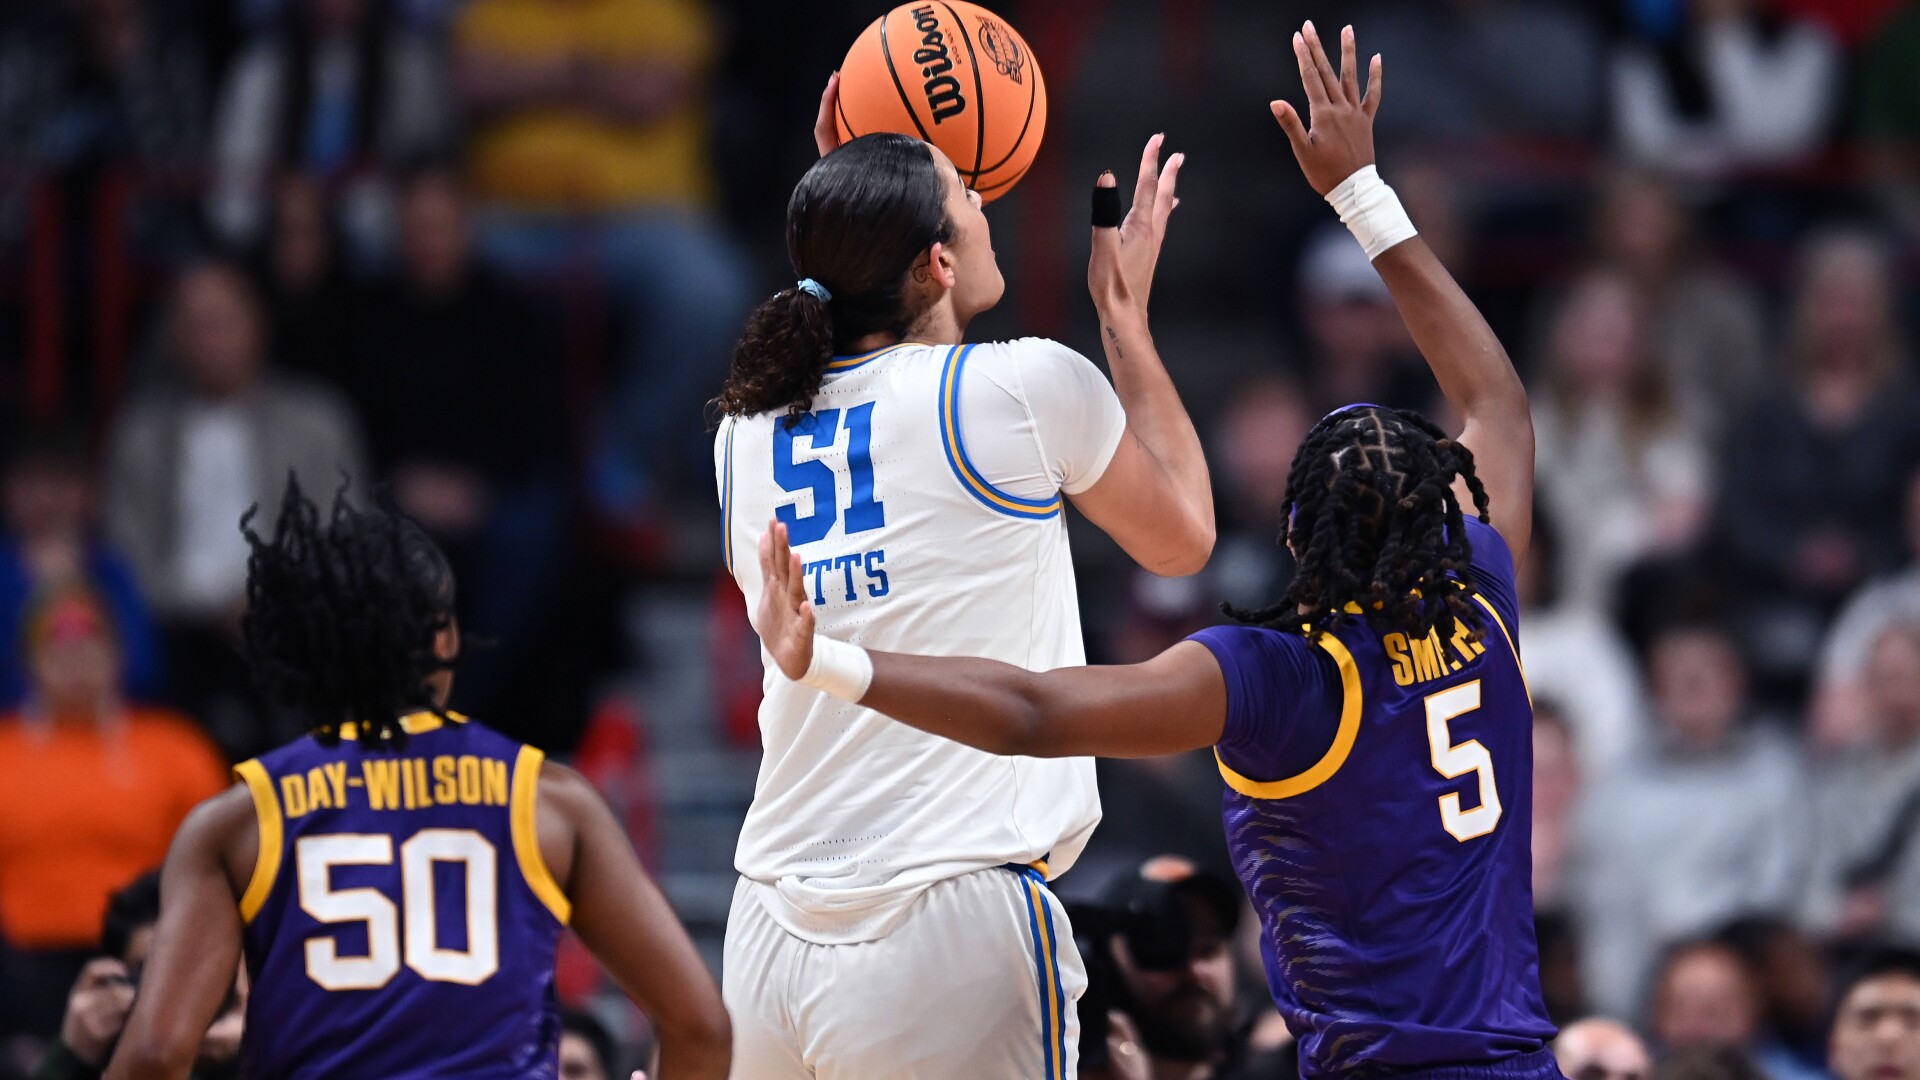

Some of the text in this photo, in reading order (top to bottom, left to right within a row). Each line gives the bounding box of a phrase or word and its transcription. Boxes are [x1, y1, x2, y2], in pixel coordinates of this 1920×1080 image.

[911, 4, 966, 126] Wilson
[772, 400, 885, 548] 51
[801, 549, 890, 606] TTS
[280, 754, 508, 819] DAY-WILSON
[1423, 678, 1502, 843] 5
[295, 828, 499, 992] 50
